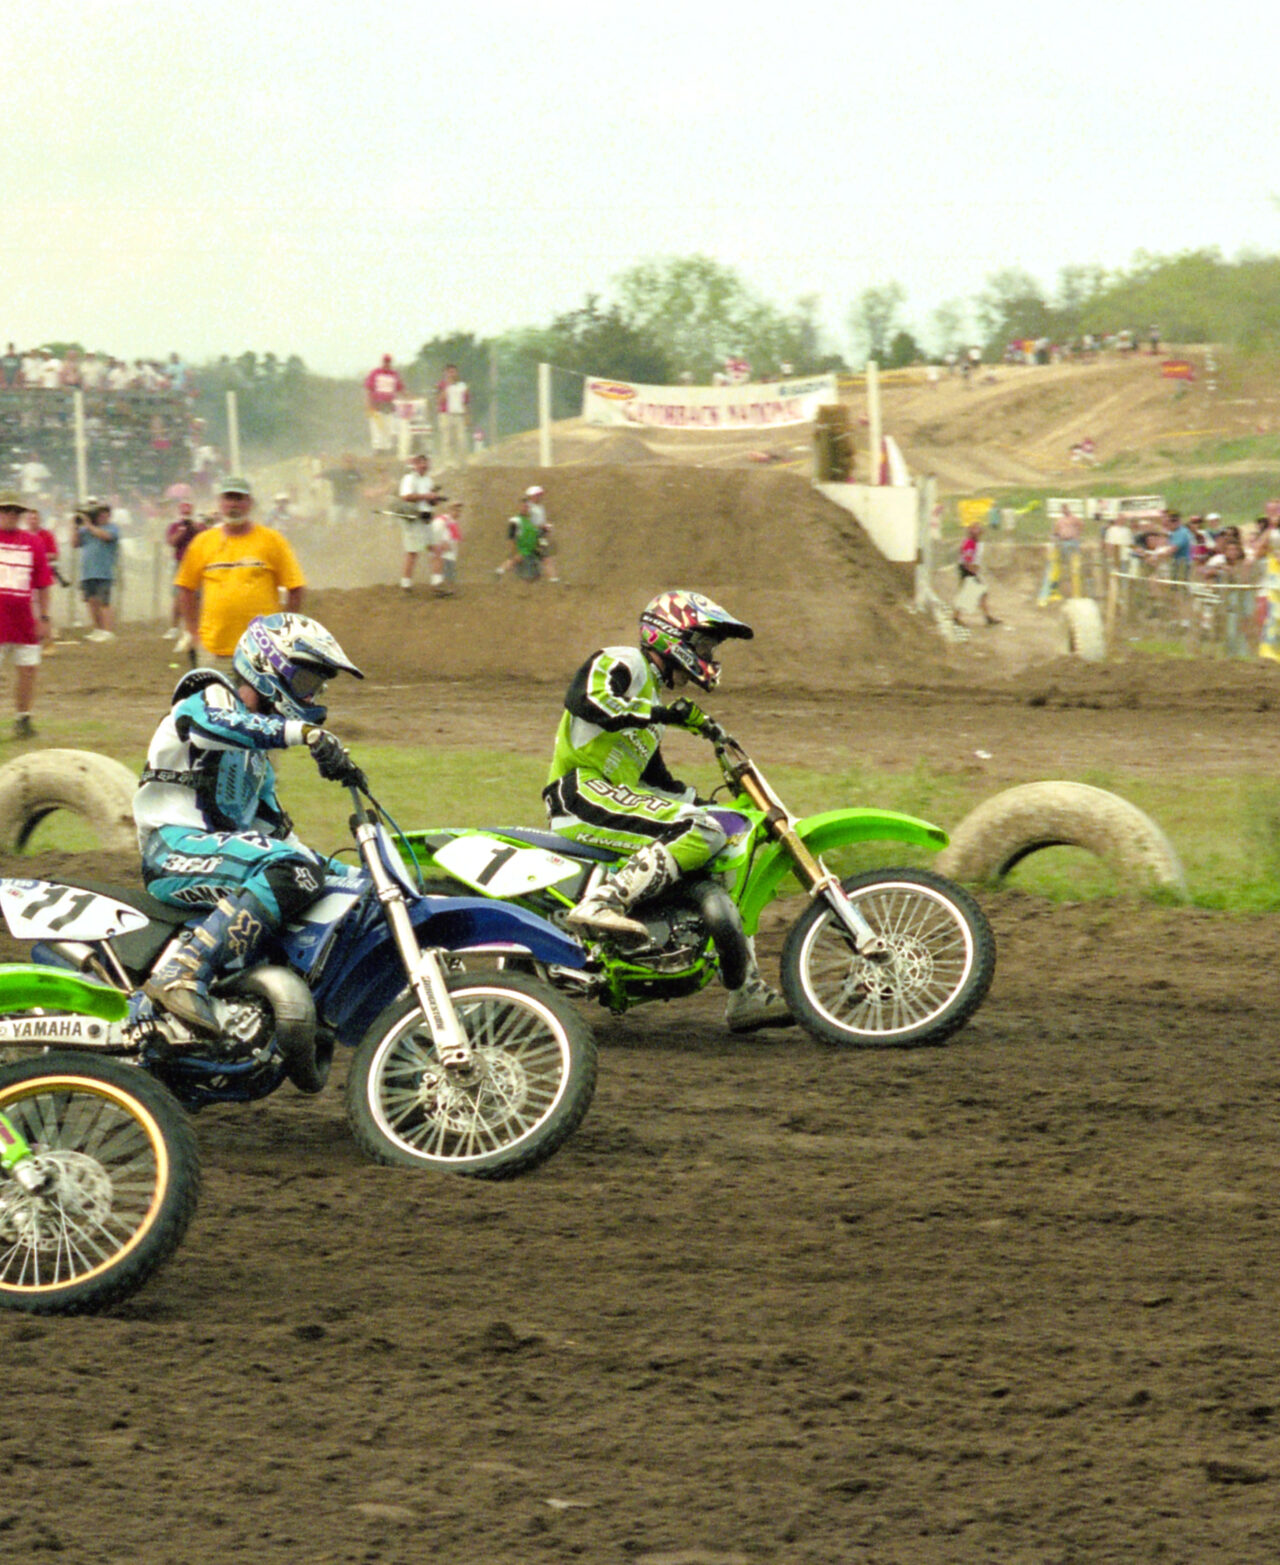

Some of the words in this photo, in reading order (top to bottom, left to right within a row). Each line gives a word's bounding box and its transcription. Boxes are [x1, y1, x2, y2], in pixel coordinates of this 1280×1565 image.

[249, 622, 294, 676] SCOTT
[584, 779, 673, 812] SHIFT
[575, 832, 643, 851] Kawasa
[475, 847, 518, 887] 1
[20, 886, 98, 933] 11
[12, 1021, 83, 1038] YAMAHA
